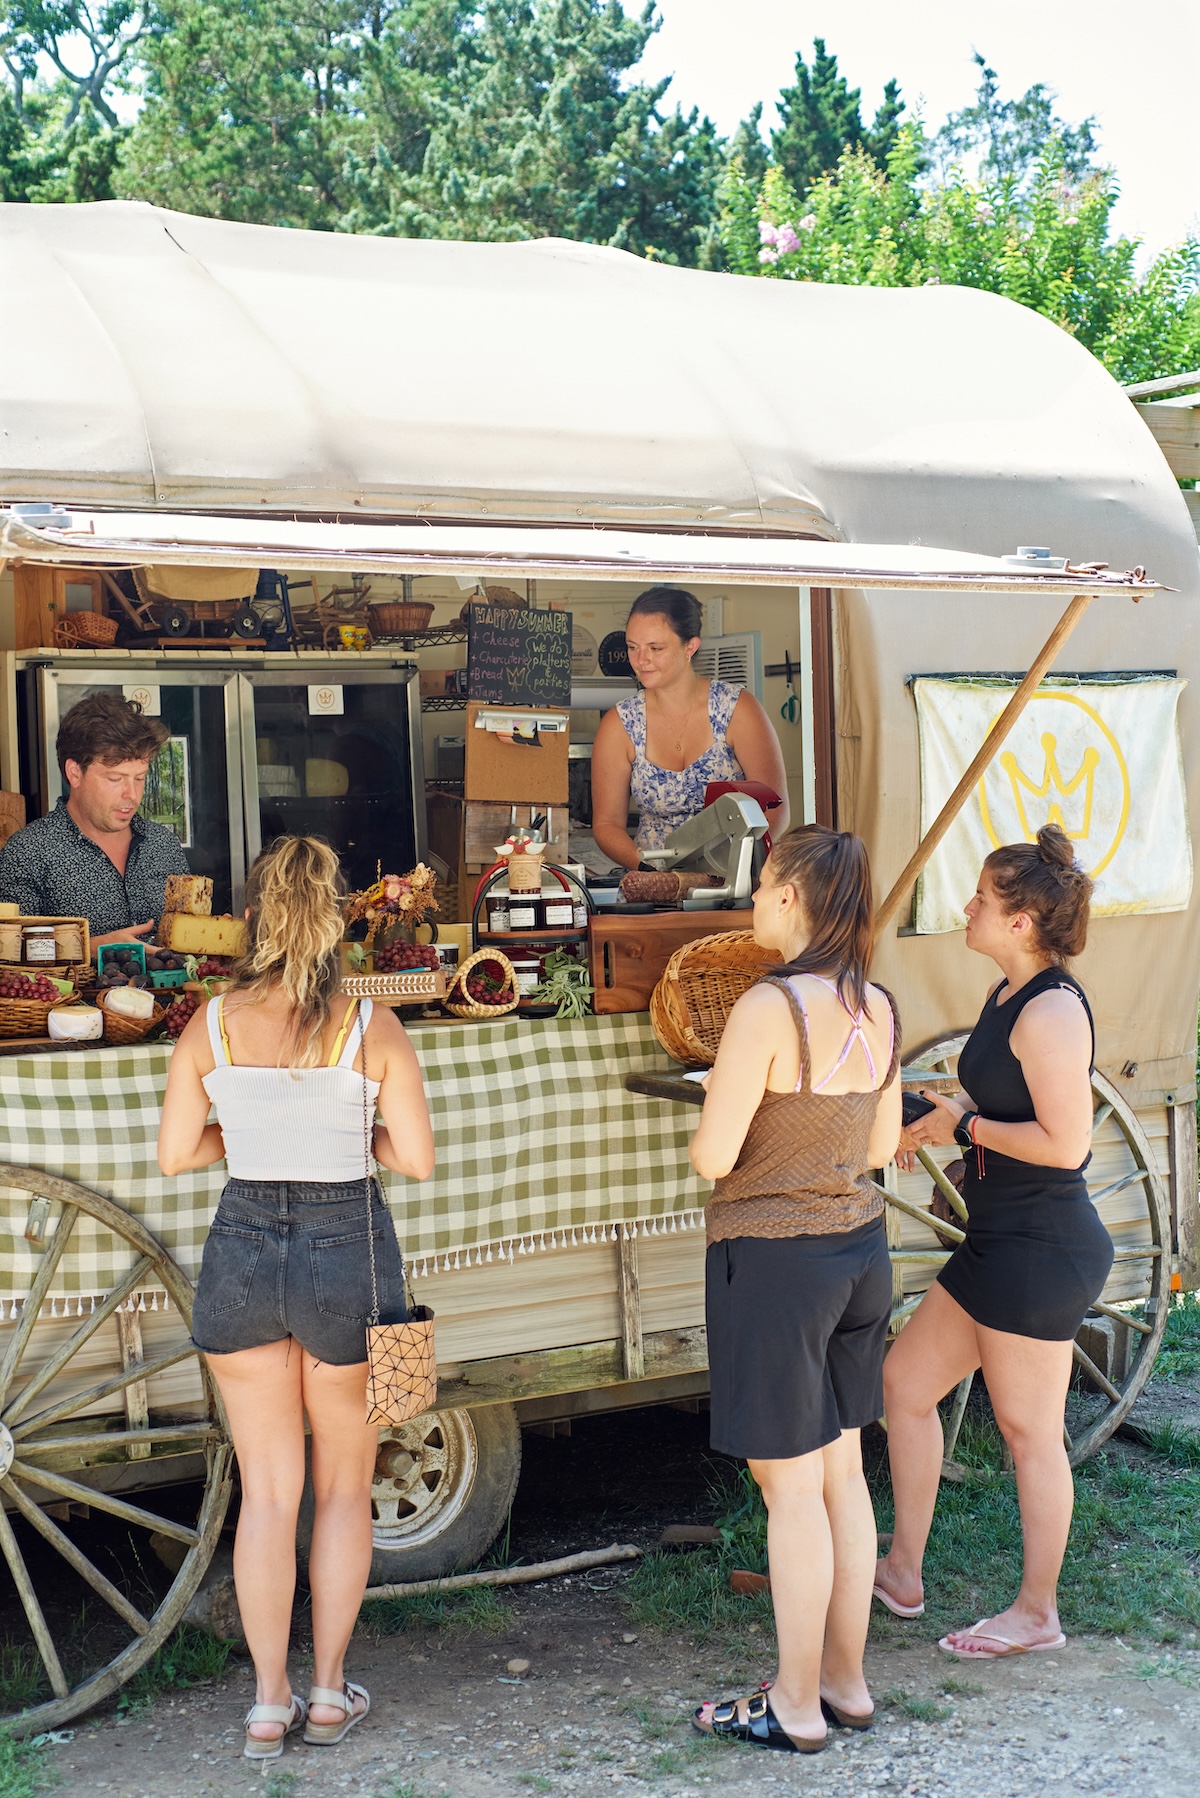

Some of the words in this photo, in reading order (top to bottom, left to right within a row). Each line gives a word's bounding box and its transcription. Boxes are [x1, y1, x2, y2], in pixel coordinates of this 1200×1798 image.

[474, 606, 519, 631] HAPPY
[517, 609, 569, 636] SUMMER
[482, 631, 520, 648] Cheese
[532, 640, 547, 653] We
[549, 641, 562, 654] do
[479, 651, 529, 666] Charcuterie
[532, 653, 570, 670] platters
[607, 650, 628, 664] 199
[533, 673, 569, 691] parties
